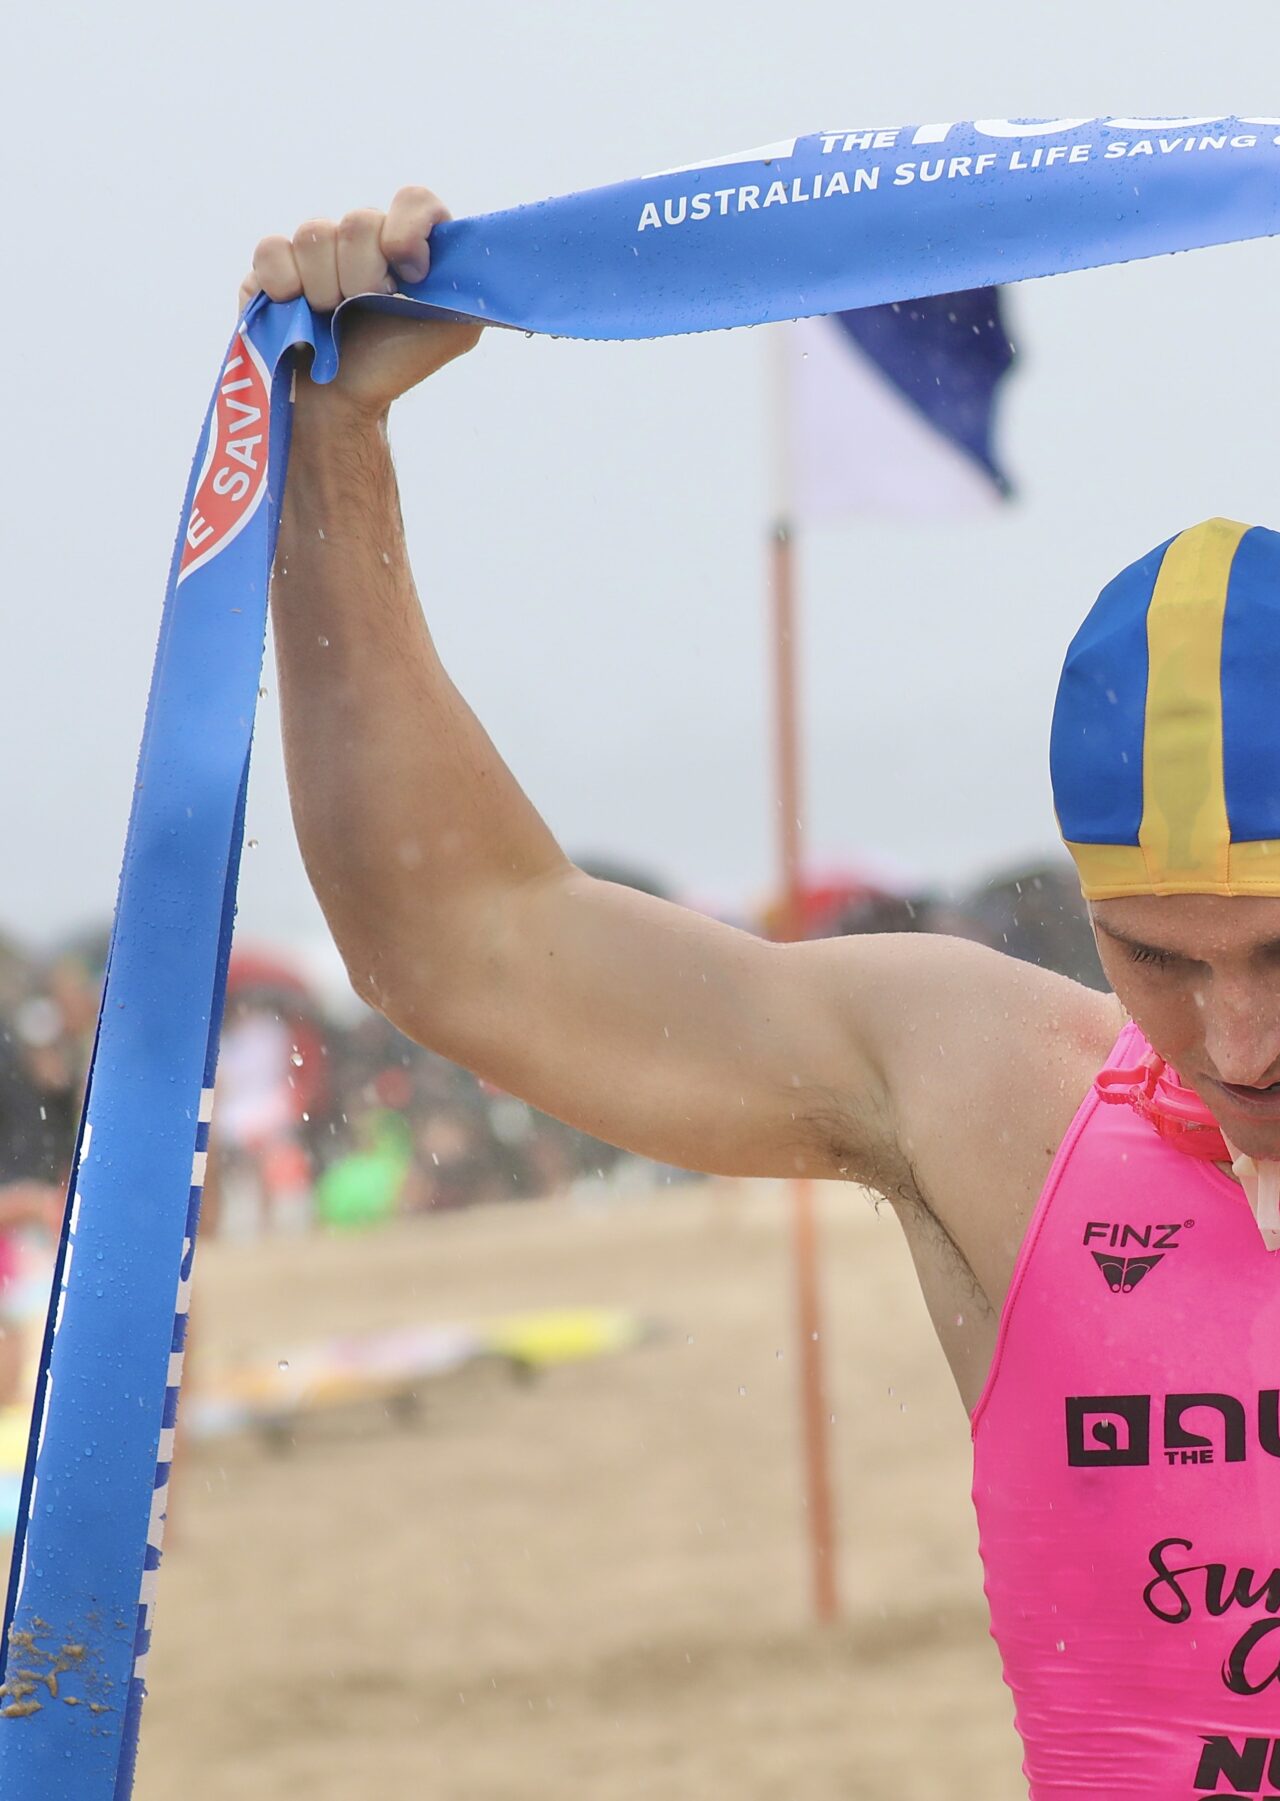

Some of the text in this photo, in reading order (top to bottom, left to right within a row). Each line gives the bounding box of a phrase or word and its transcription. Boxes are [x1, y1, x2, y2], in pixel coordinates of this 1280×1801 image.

[820, 131, 899, 154] THE
[637, 166, 880, 232] AUSTRALIAN
[892, 152, 998, 187] SURF
[1008, 140, 1090, 172] LIFE
[1103, 134, 1257, 160] SAVING
[1164, 1448, 1214, 1465] THE
